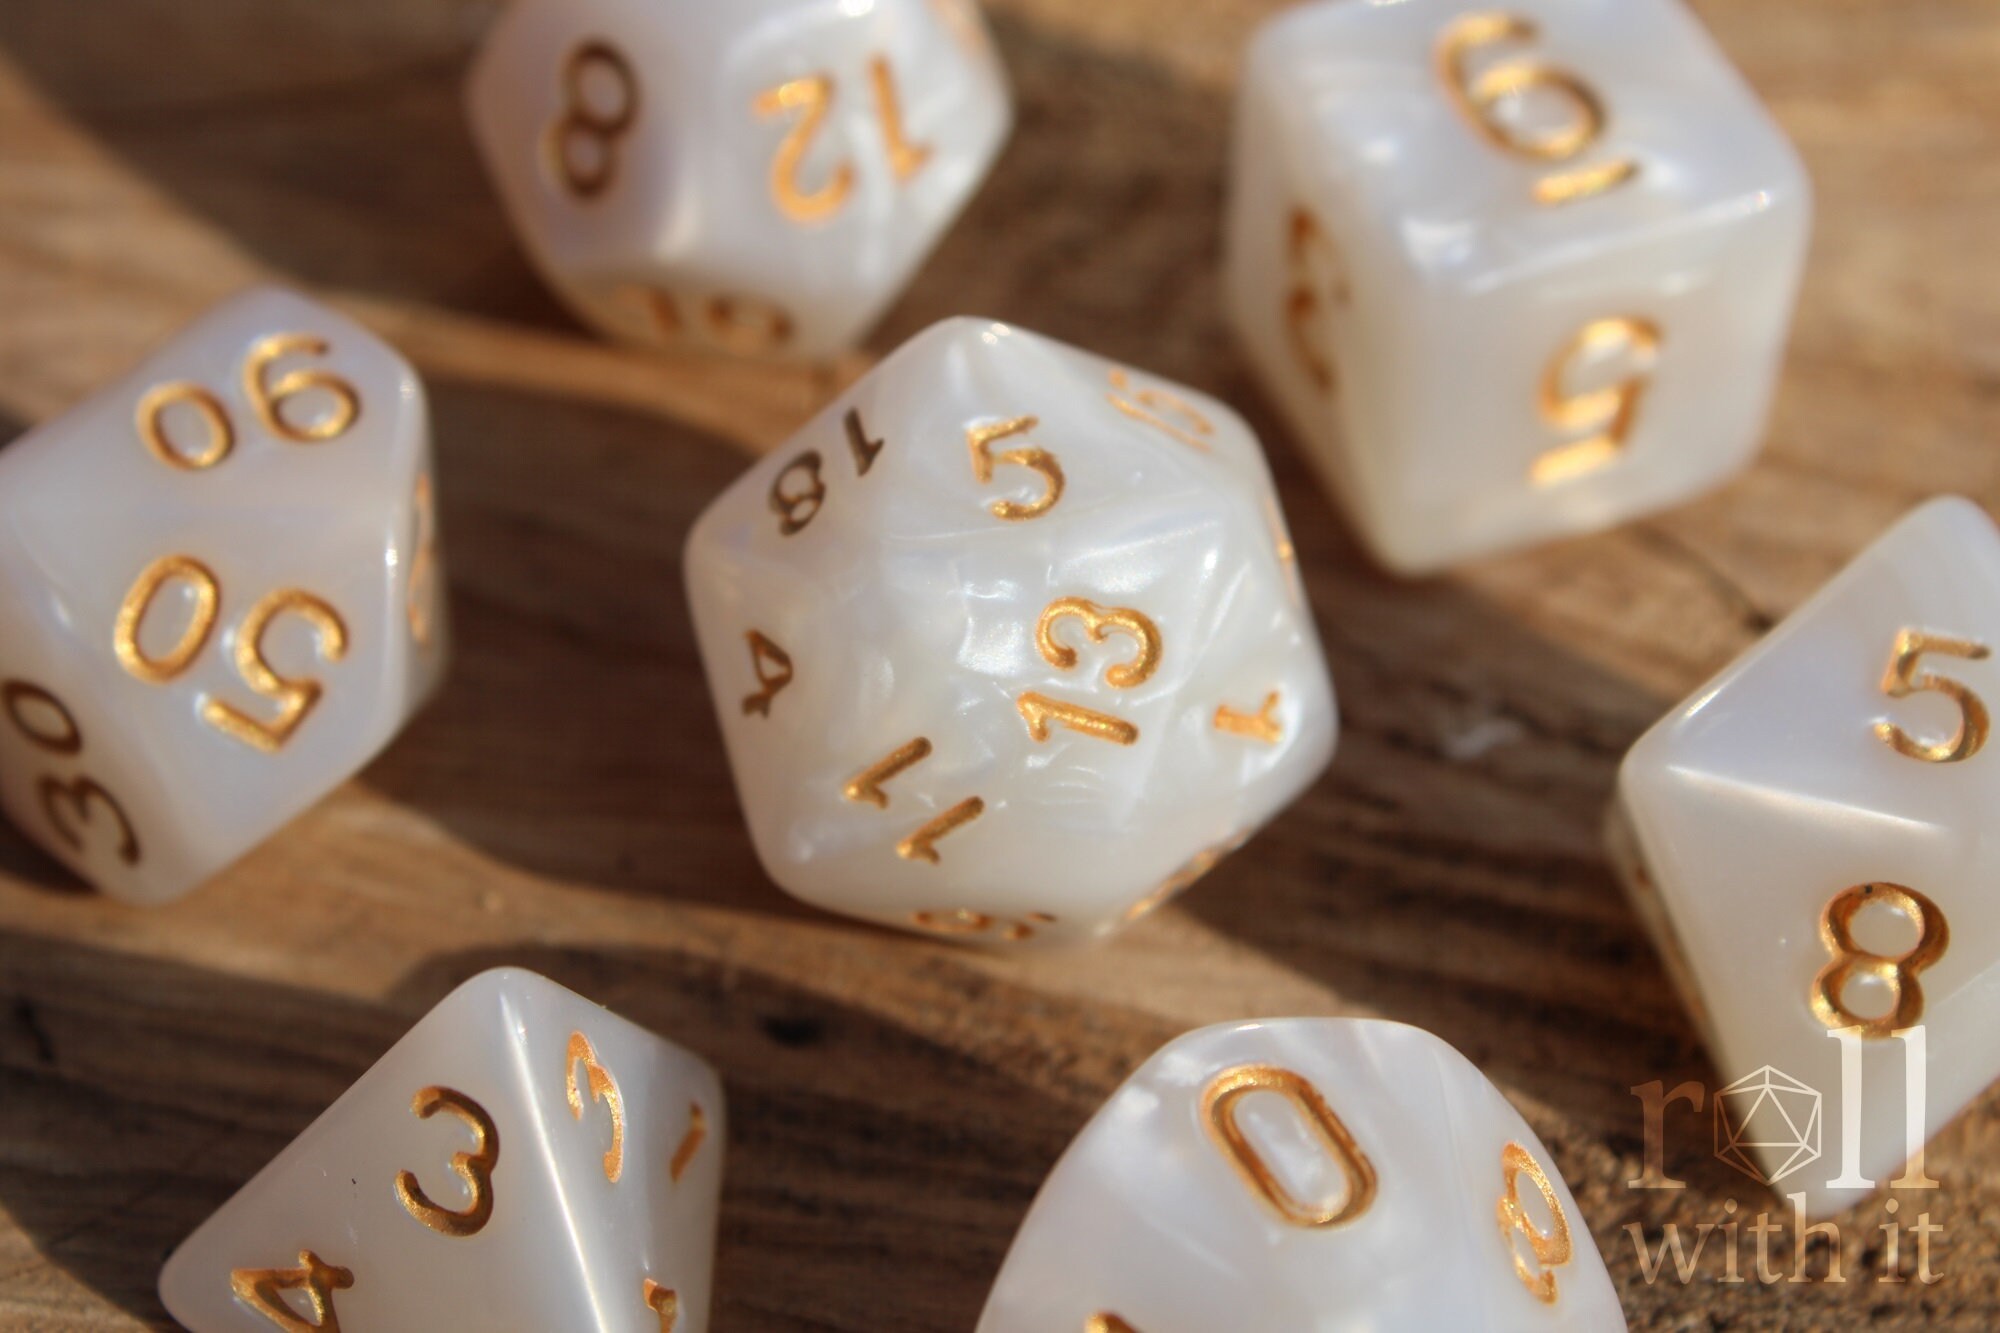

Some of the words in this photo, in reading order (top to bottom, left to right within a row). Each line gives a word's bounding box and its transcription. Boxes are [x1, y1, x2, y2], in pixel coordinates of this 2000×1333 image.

[540, 35, 641, 202] 8
[752, 54, 935, 231] 12
[768, 405, 885, 537] 18
[963, 412, 1066, 522] 5
[1527, 315, 1664, 488] 5
[113, 553, 348, 752] 50
[740, 627, 794, 721] 4
[1015, 596, 1164, 746] 13
[1873, 625, 1992, 764] 5
[843, 735, 986, 866] 11
[1809, 880, 1951, 1042] 8
[397, 1085, 500, 1238] 3
[1198, 1063, 1379, 1229] 0
